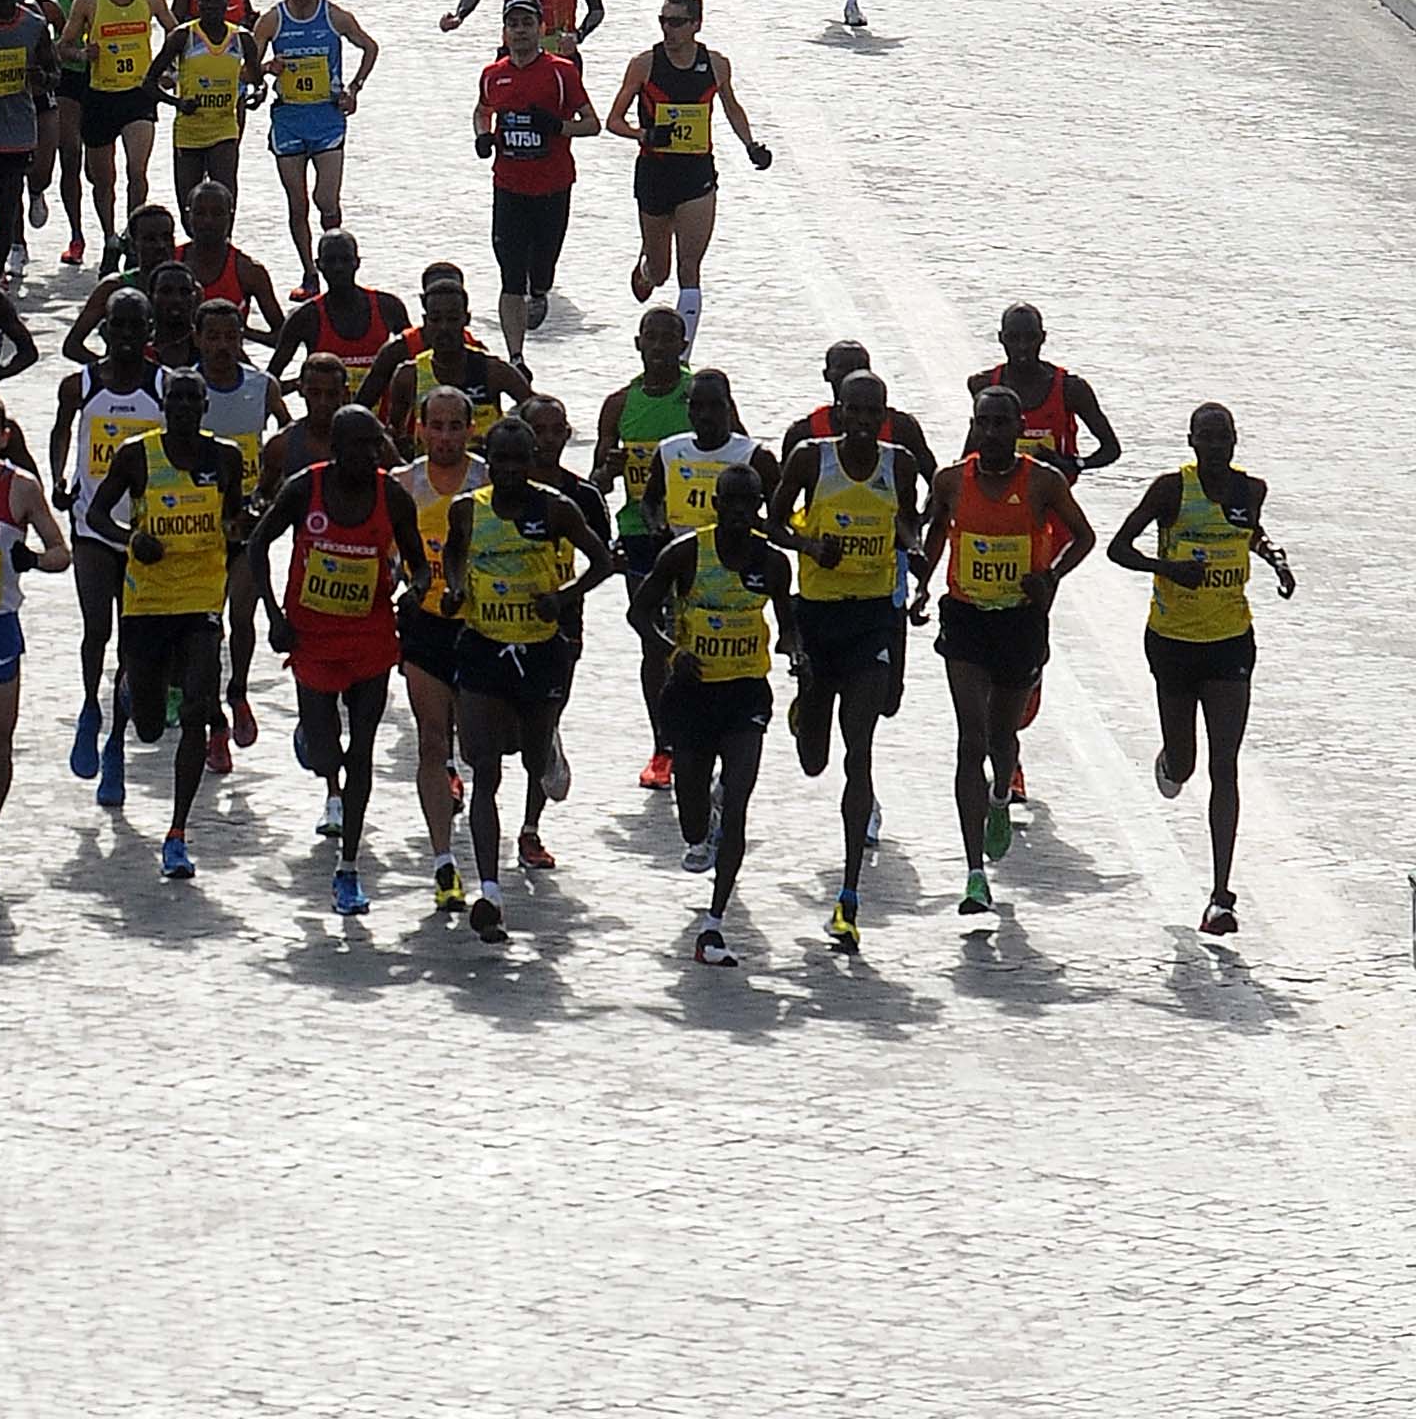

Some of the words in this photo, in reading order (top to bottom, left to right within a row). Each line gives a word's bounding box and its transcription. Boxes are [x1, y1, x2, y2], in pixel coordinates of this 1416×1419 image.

[116, 58, 134, 73] 38
[295, 75, 314, 93] 49
[673, 126, 693, 141] 42
[93, 442, 115, 464] KA
[629, 465, 649, 484] DE
[687, 488, 706, 508] 41
[972, 561, 1018, 582] BEYU
[1202, 568, 1245, 589] NSON
[308, 574, 370, 604] OLOISA
[482, 602, 536, 622] MATTE
[695, 635, 759, 657] ROTICH
